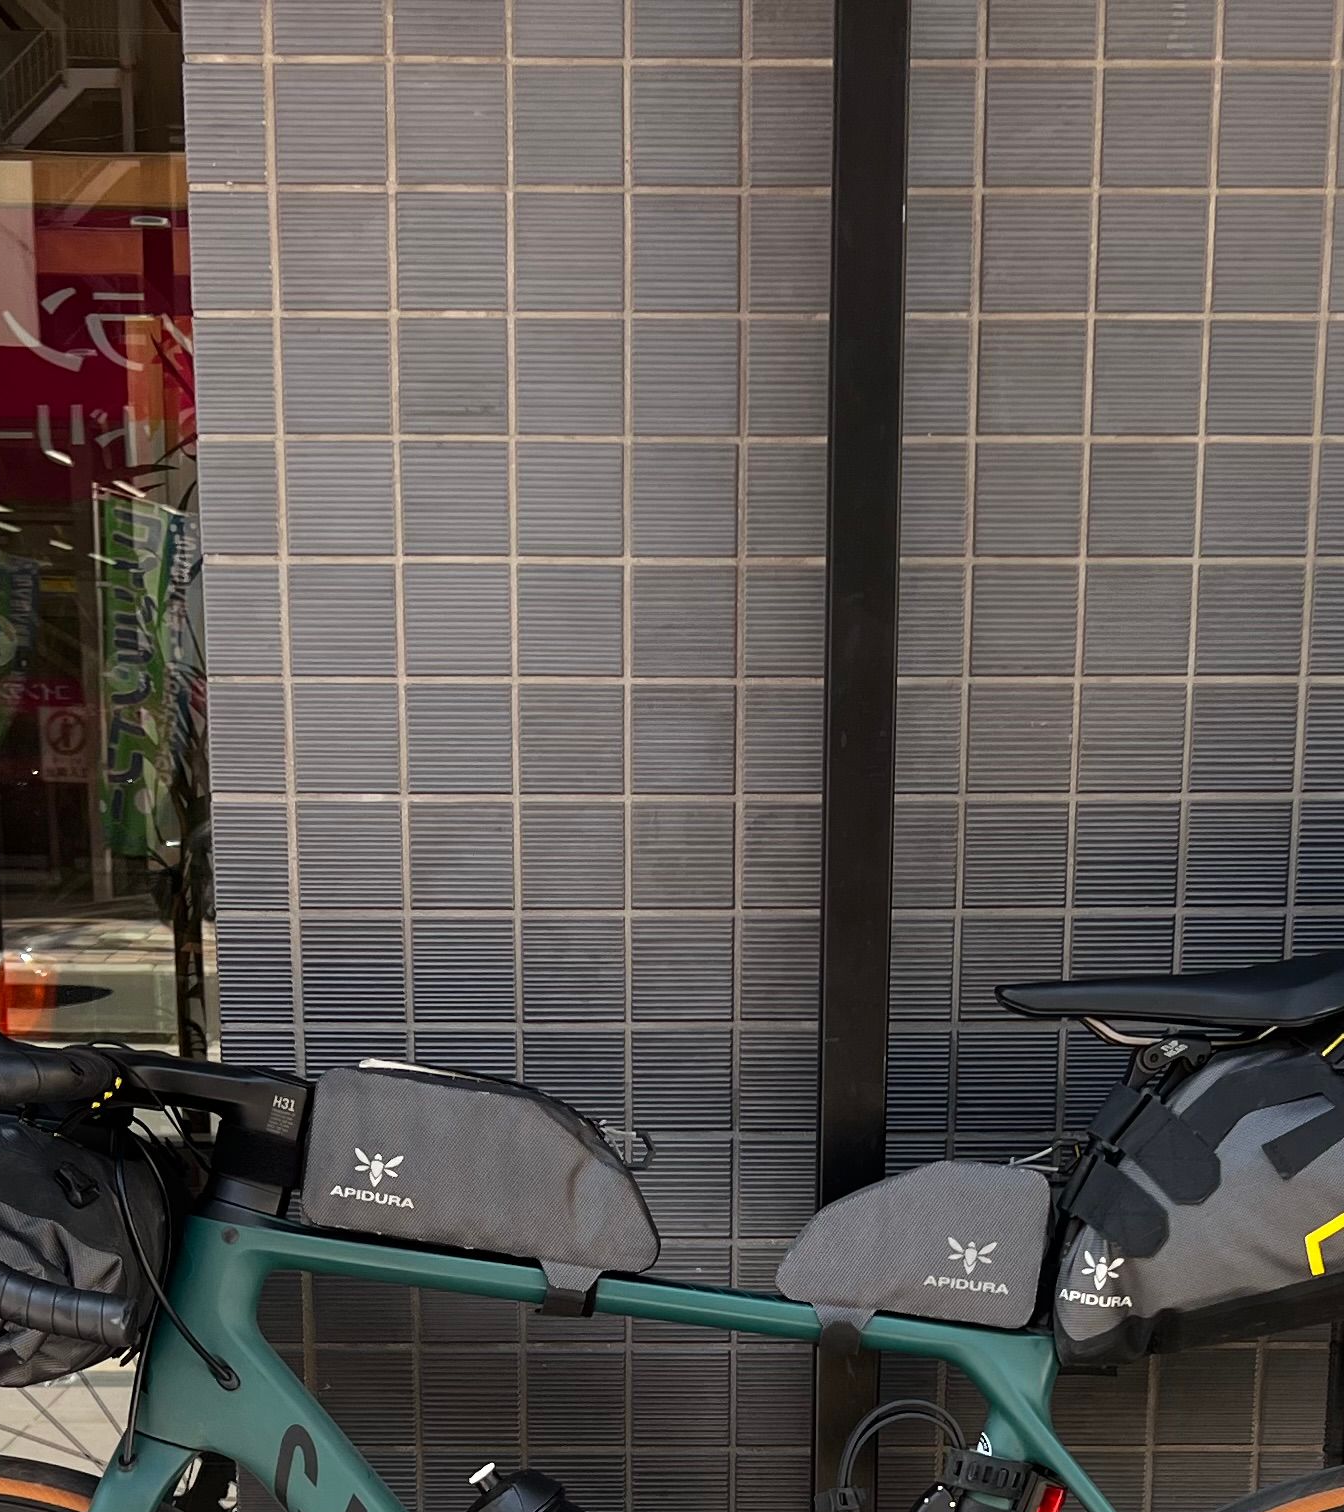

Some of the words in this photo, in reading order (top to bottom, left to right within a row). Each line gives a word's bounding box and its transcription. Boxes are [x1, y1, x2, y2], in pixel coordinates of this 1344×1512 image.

[272, 1094, 296, 1112] H31
[330, 1185, 414, 1209] APIDURA
[923, 1275, 1009, 1295] APIDURA
[1059, 1288, 1133, 1308] APIDURA
